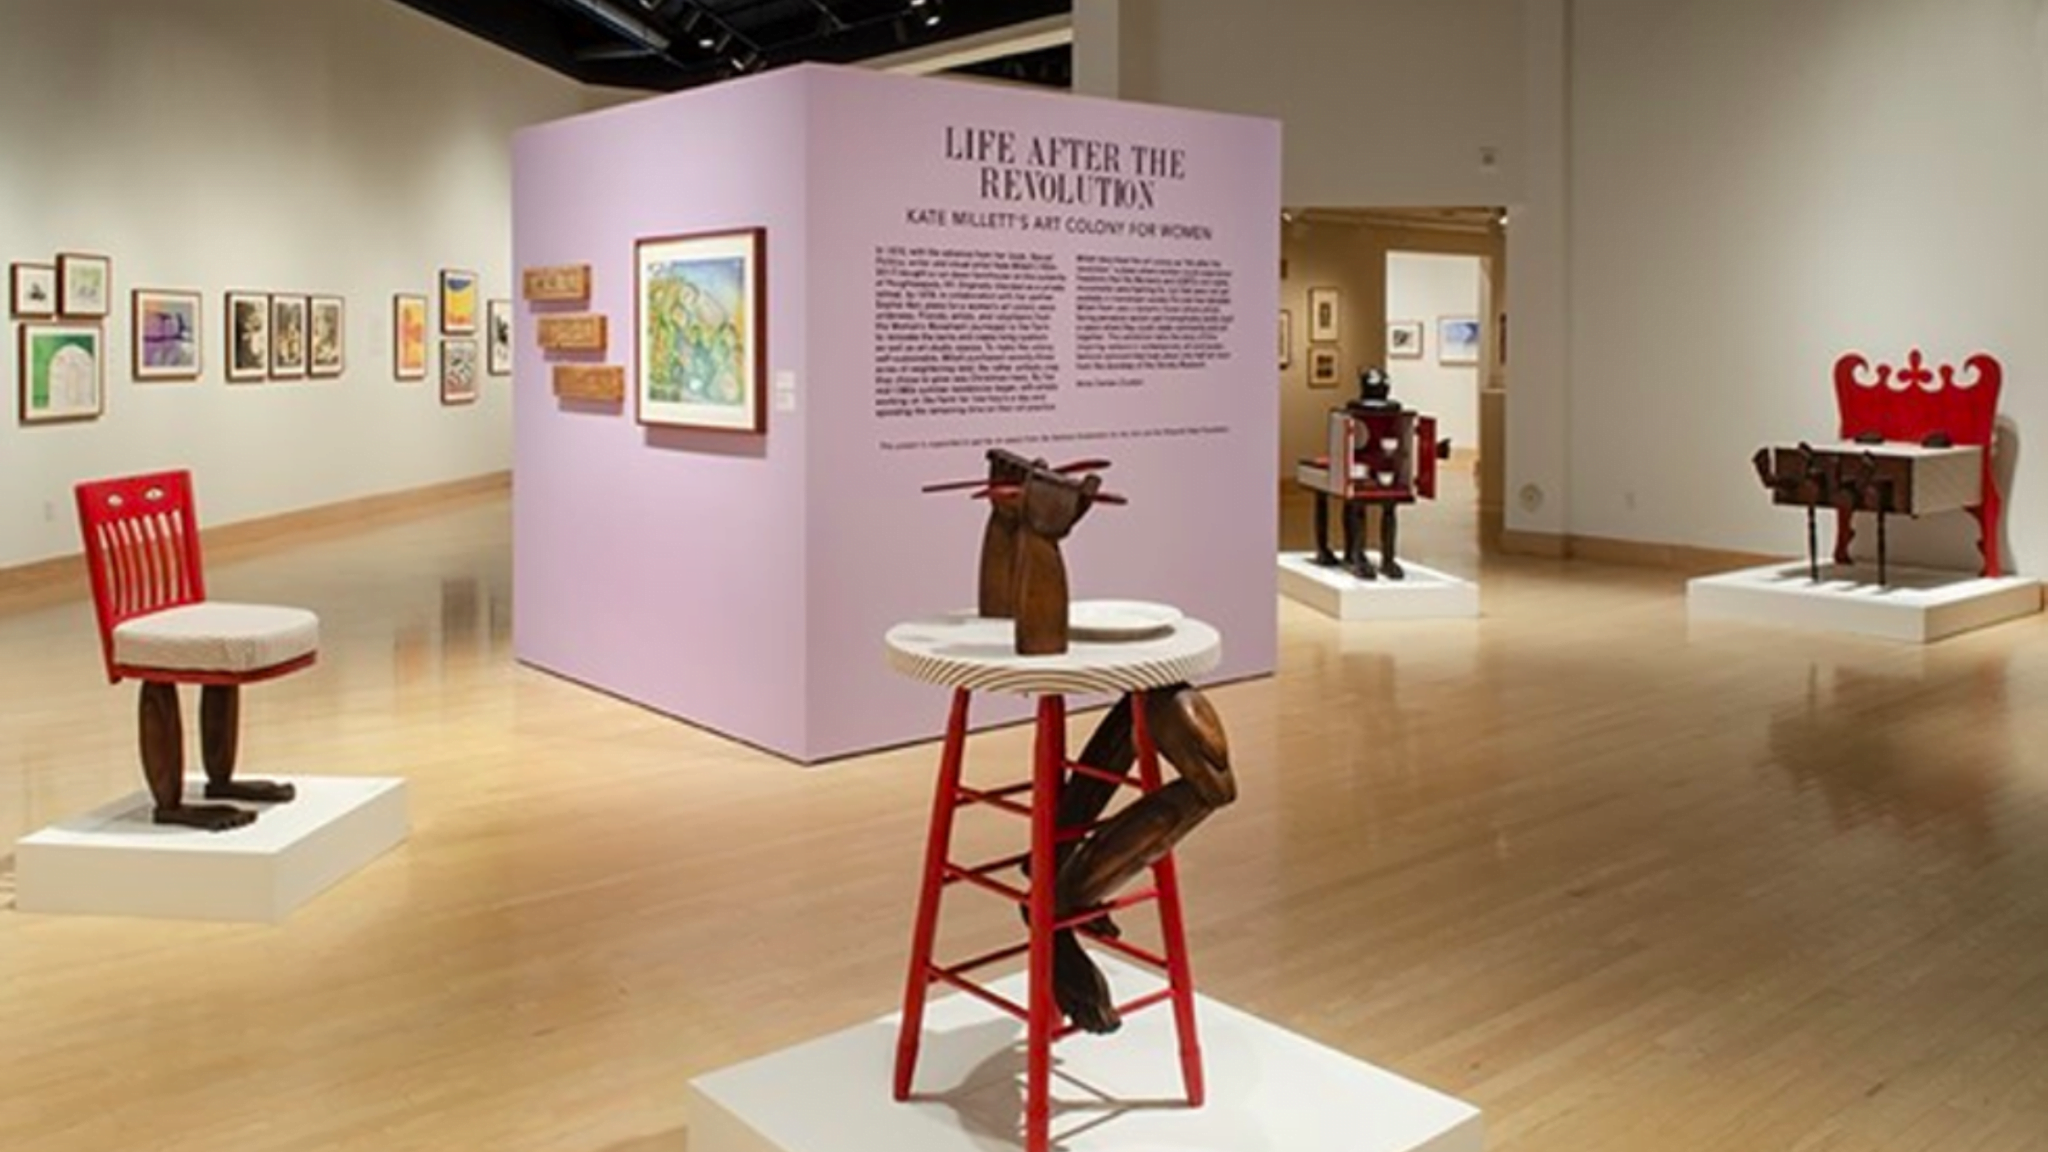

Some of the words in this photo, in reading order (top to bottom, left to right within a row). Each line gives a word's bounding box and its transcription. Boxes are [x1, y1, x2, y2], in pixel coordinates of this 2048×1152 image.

[945, 126, 1016, 164] LIFE
[1028, 136, 1120, 173] AFTER
[1131, 145, 1186, 180] THE
[980, 167, 1154, 210] REVOLUTION
[906, 208, 946, 227] KATE
[952, 210, 1029, 231] MILLETT'S
[1033, 215, 1061, 232] ART
[1065, 217, 1126, 236] COLONY
[1129, 221, 1156, 238] FOR
[1160, 223, 1213, 241] WOMEN
